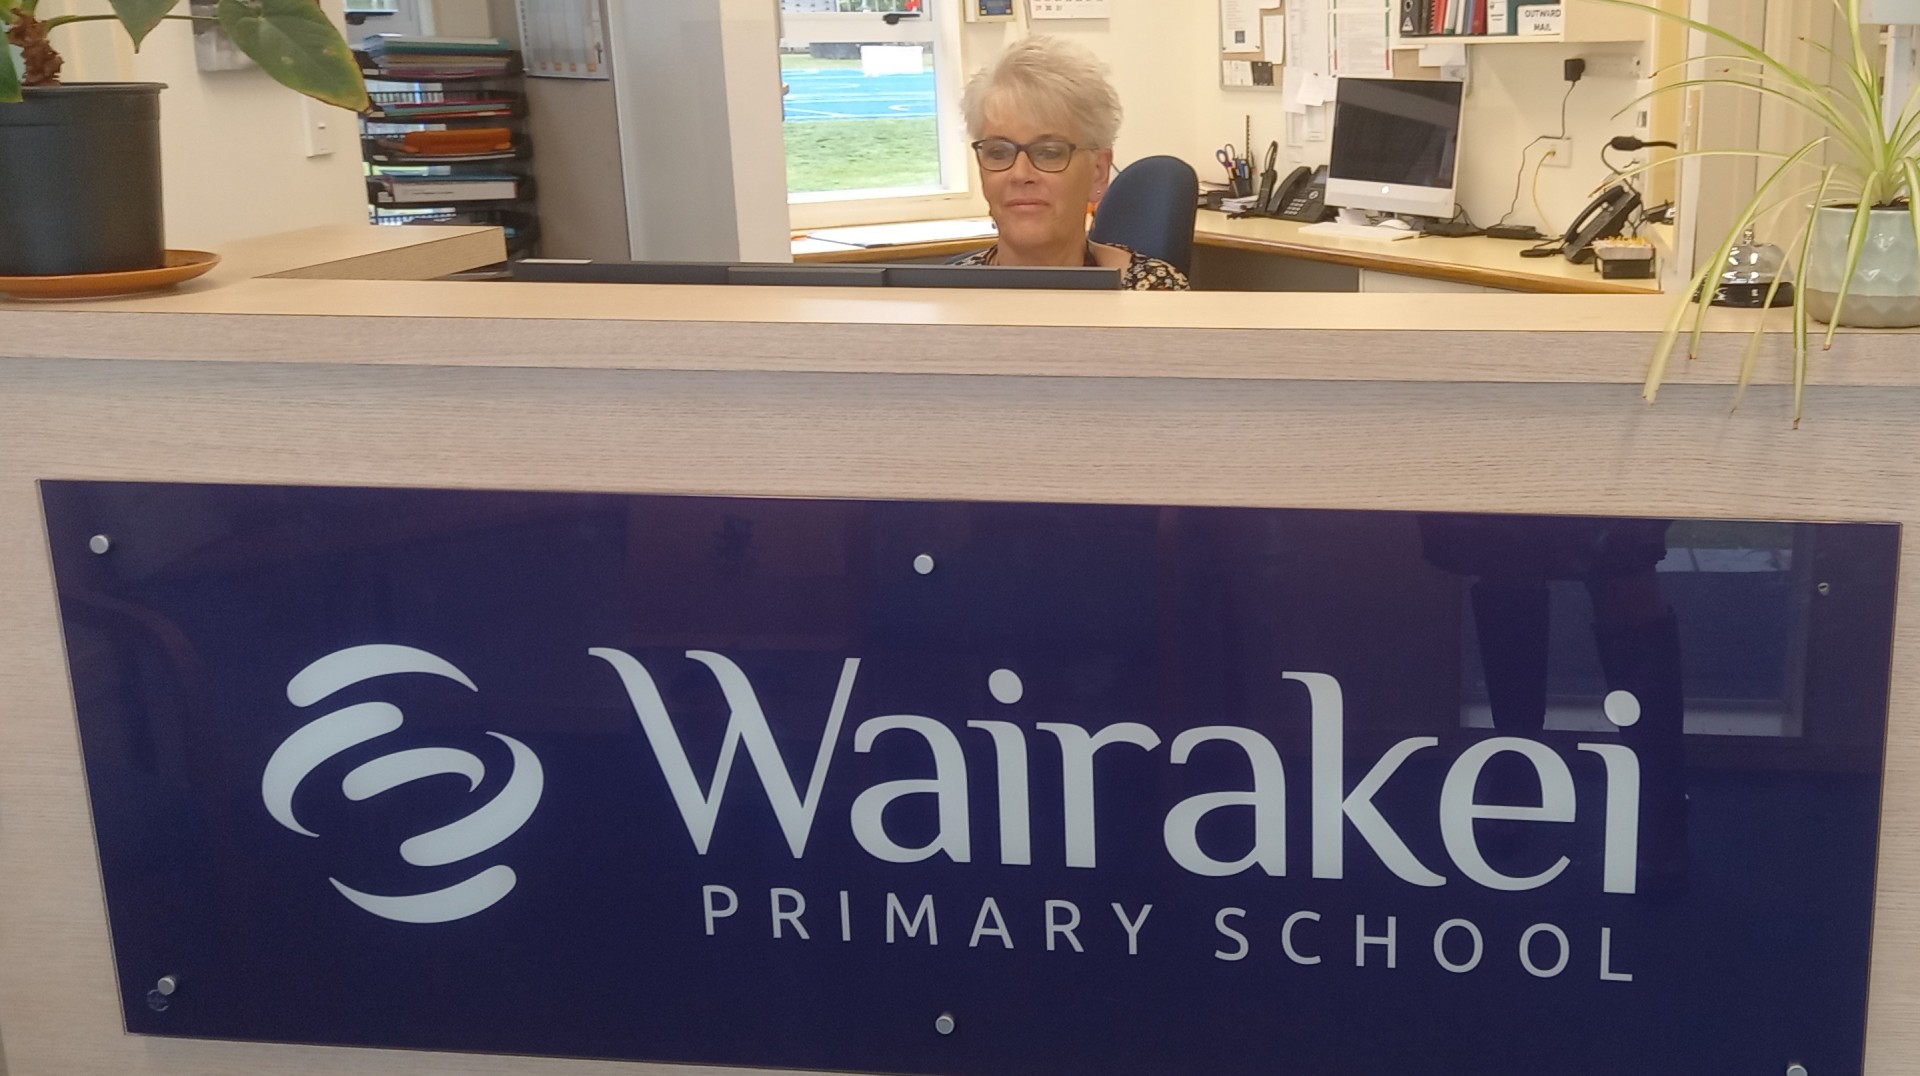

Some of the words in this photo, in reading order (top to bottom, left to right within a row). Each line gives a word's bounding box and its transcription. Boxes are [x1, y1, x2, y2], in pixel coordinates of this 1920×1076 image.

[1524, 8, 1561, 18] OUTWARD
[1533, 23, 1552, 31] MAIL
[589, 647, 1640, 894] Wairakei
[702, 885, 1153, 955] PRIMARY
[1215, 907, 1633, 982] SCHOOL
